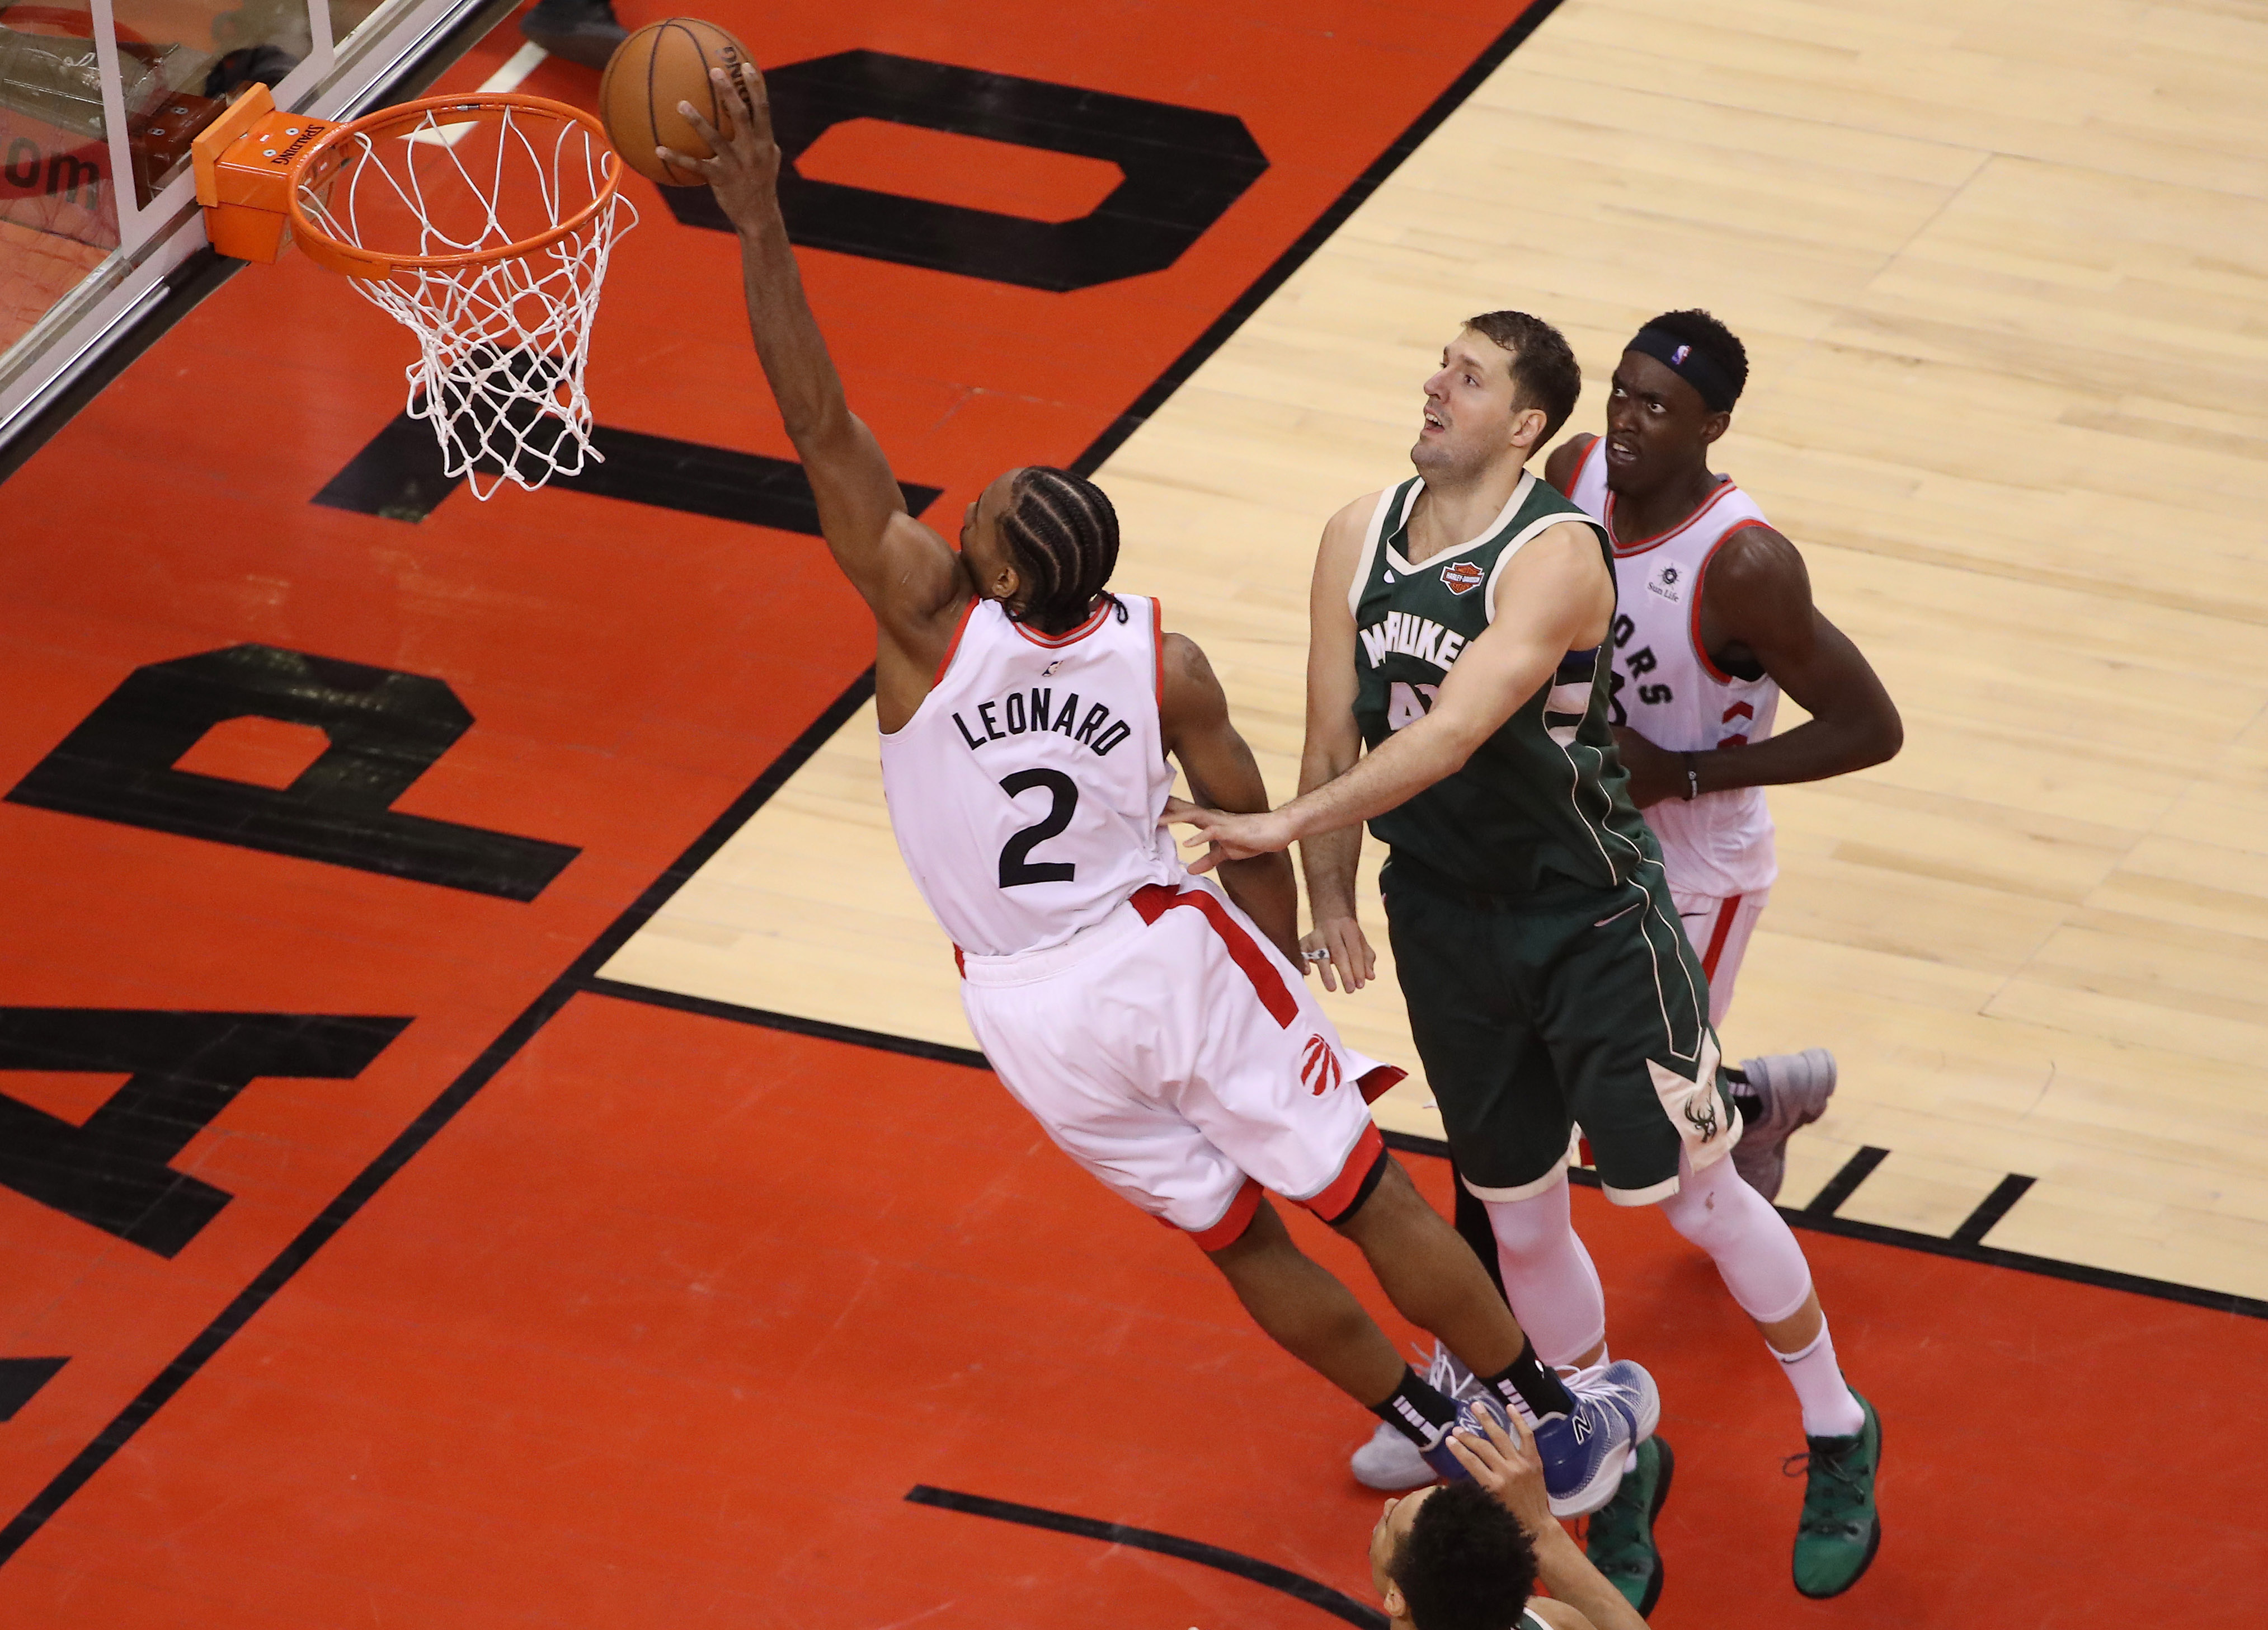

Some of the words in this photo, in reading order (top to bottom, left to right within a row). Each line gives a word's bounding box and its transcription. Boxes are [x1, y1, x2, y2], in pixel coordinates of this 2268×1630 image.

[271, 124, 325, 165] SPALDING
[1647, 581, 1663, 595] Sun
[1664, 590, 1679, 603] Life
[952, 688, 1131, 757] LEONARD
[999, 768, 1078, 889] 2
